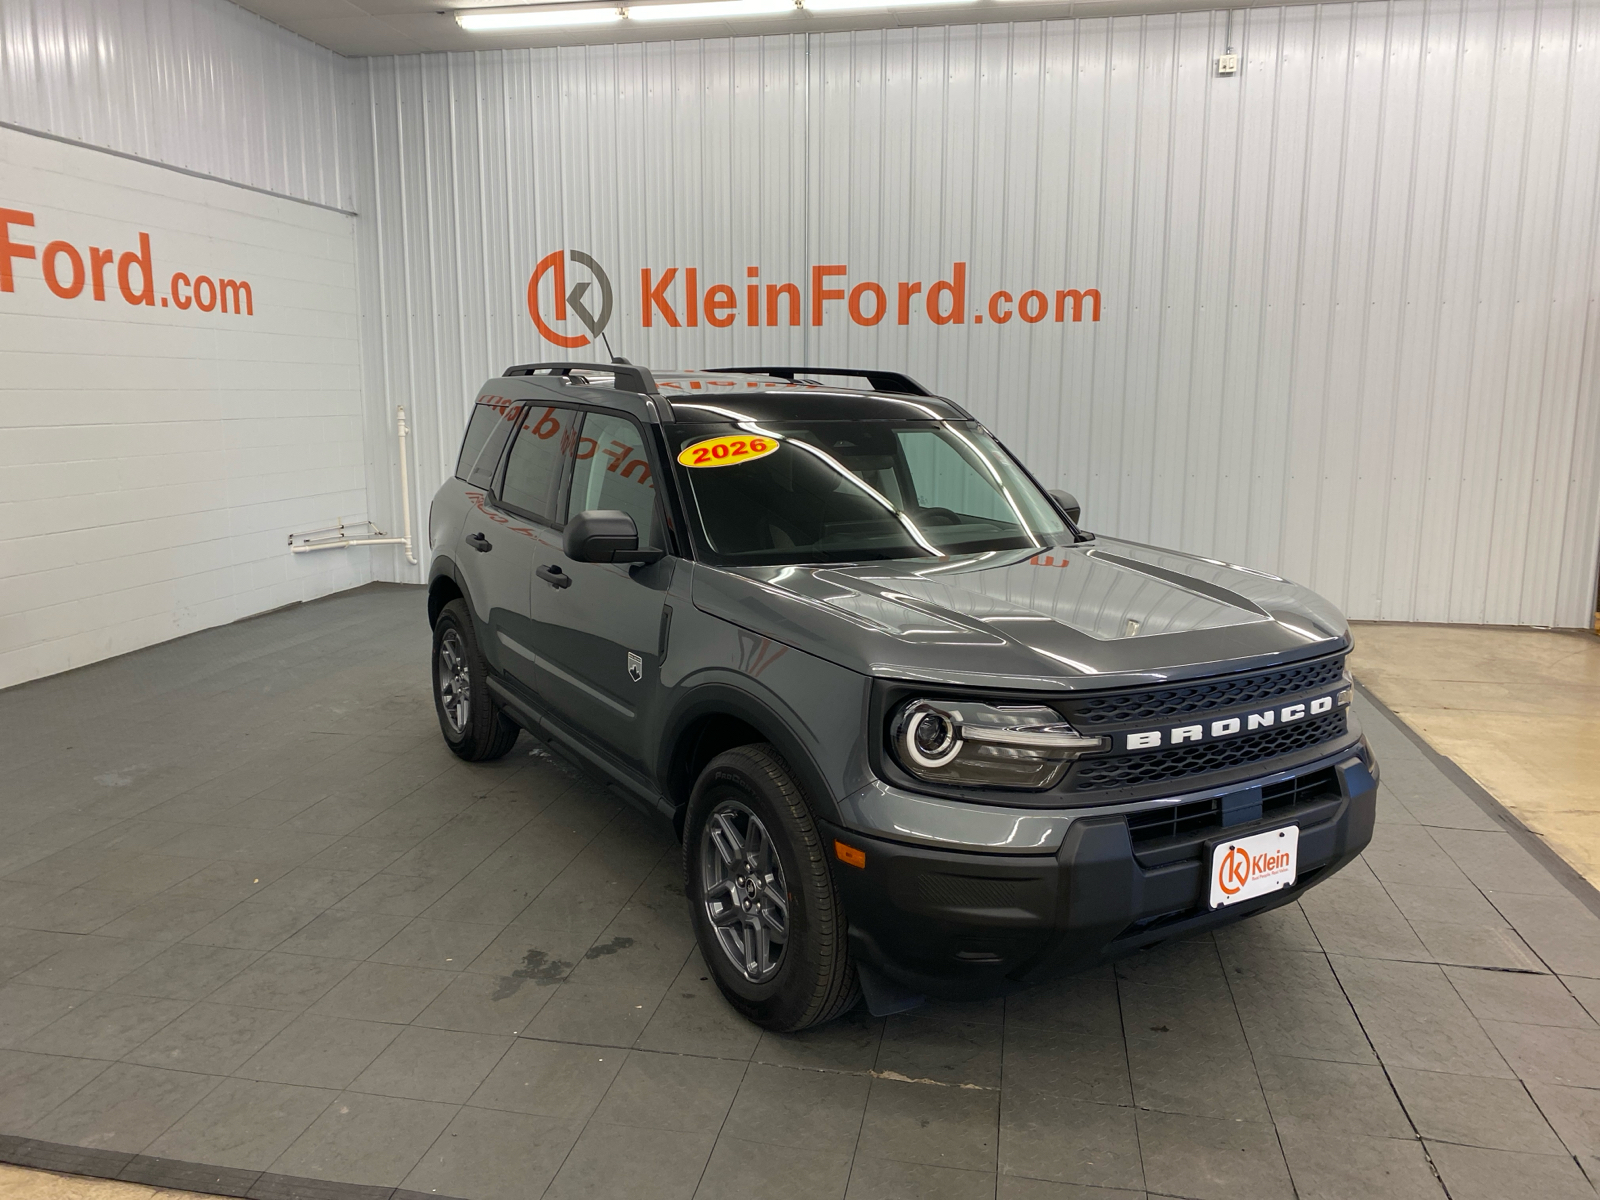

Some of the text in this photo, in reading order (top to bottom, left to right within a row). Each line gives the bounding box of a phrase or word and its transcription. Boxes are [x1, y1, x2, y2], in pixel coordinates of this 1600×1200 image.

[0, 207, 253, 316] Ford.com
[641, 262, 1101, 328] KleinFord.com
[692, 438, 768, 464] 2026
[1126, 696, 1332, 750] BRONCO
[1252, 850, 1289, 875] Klein
